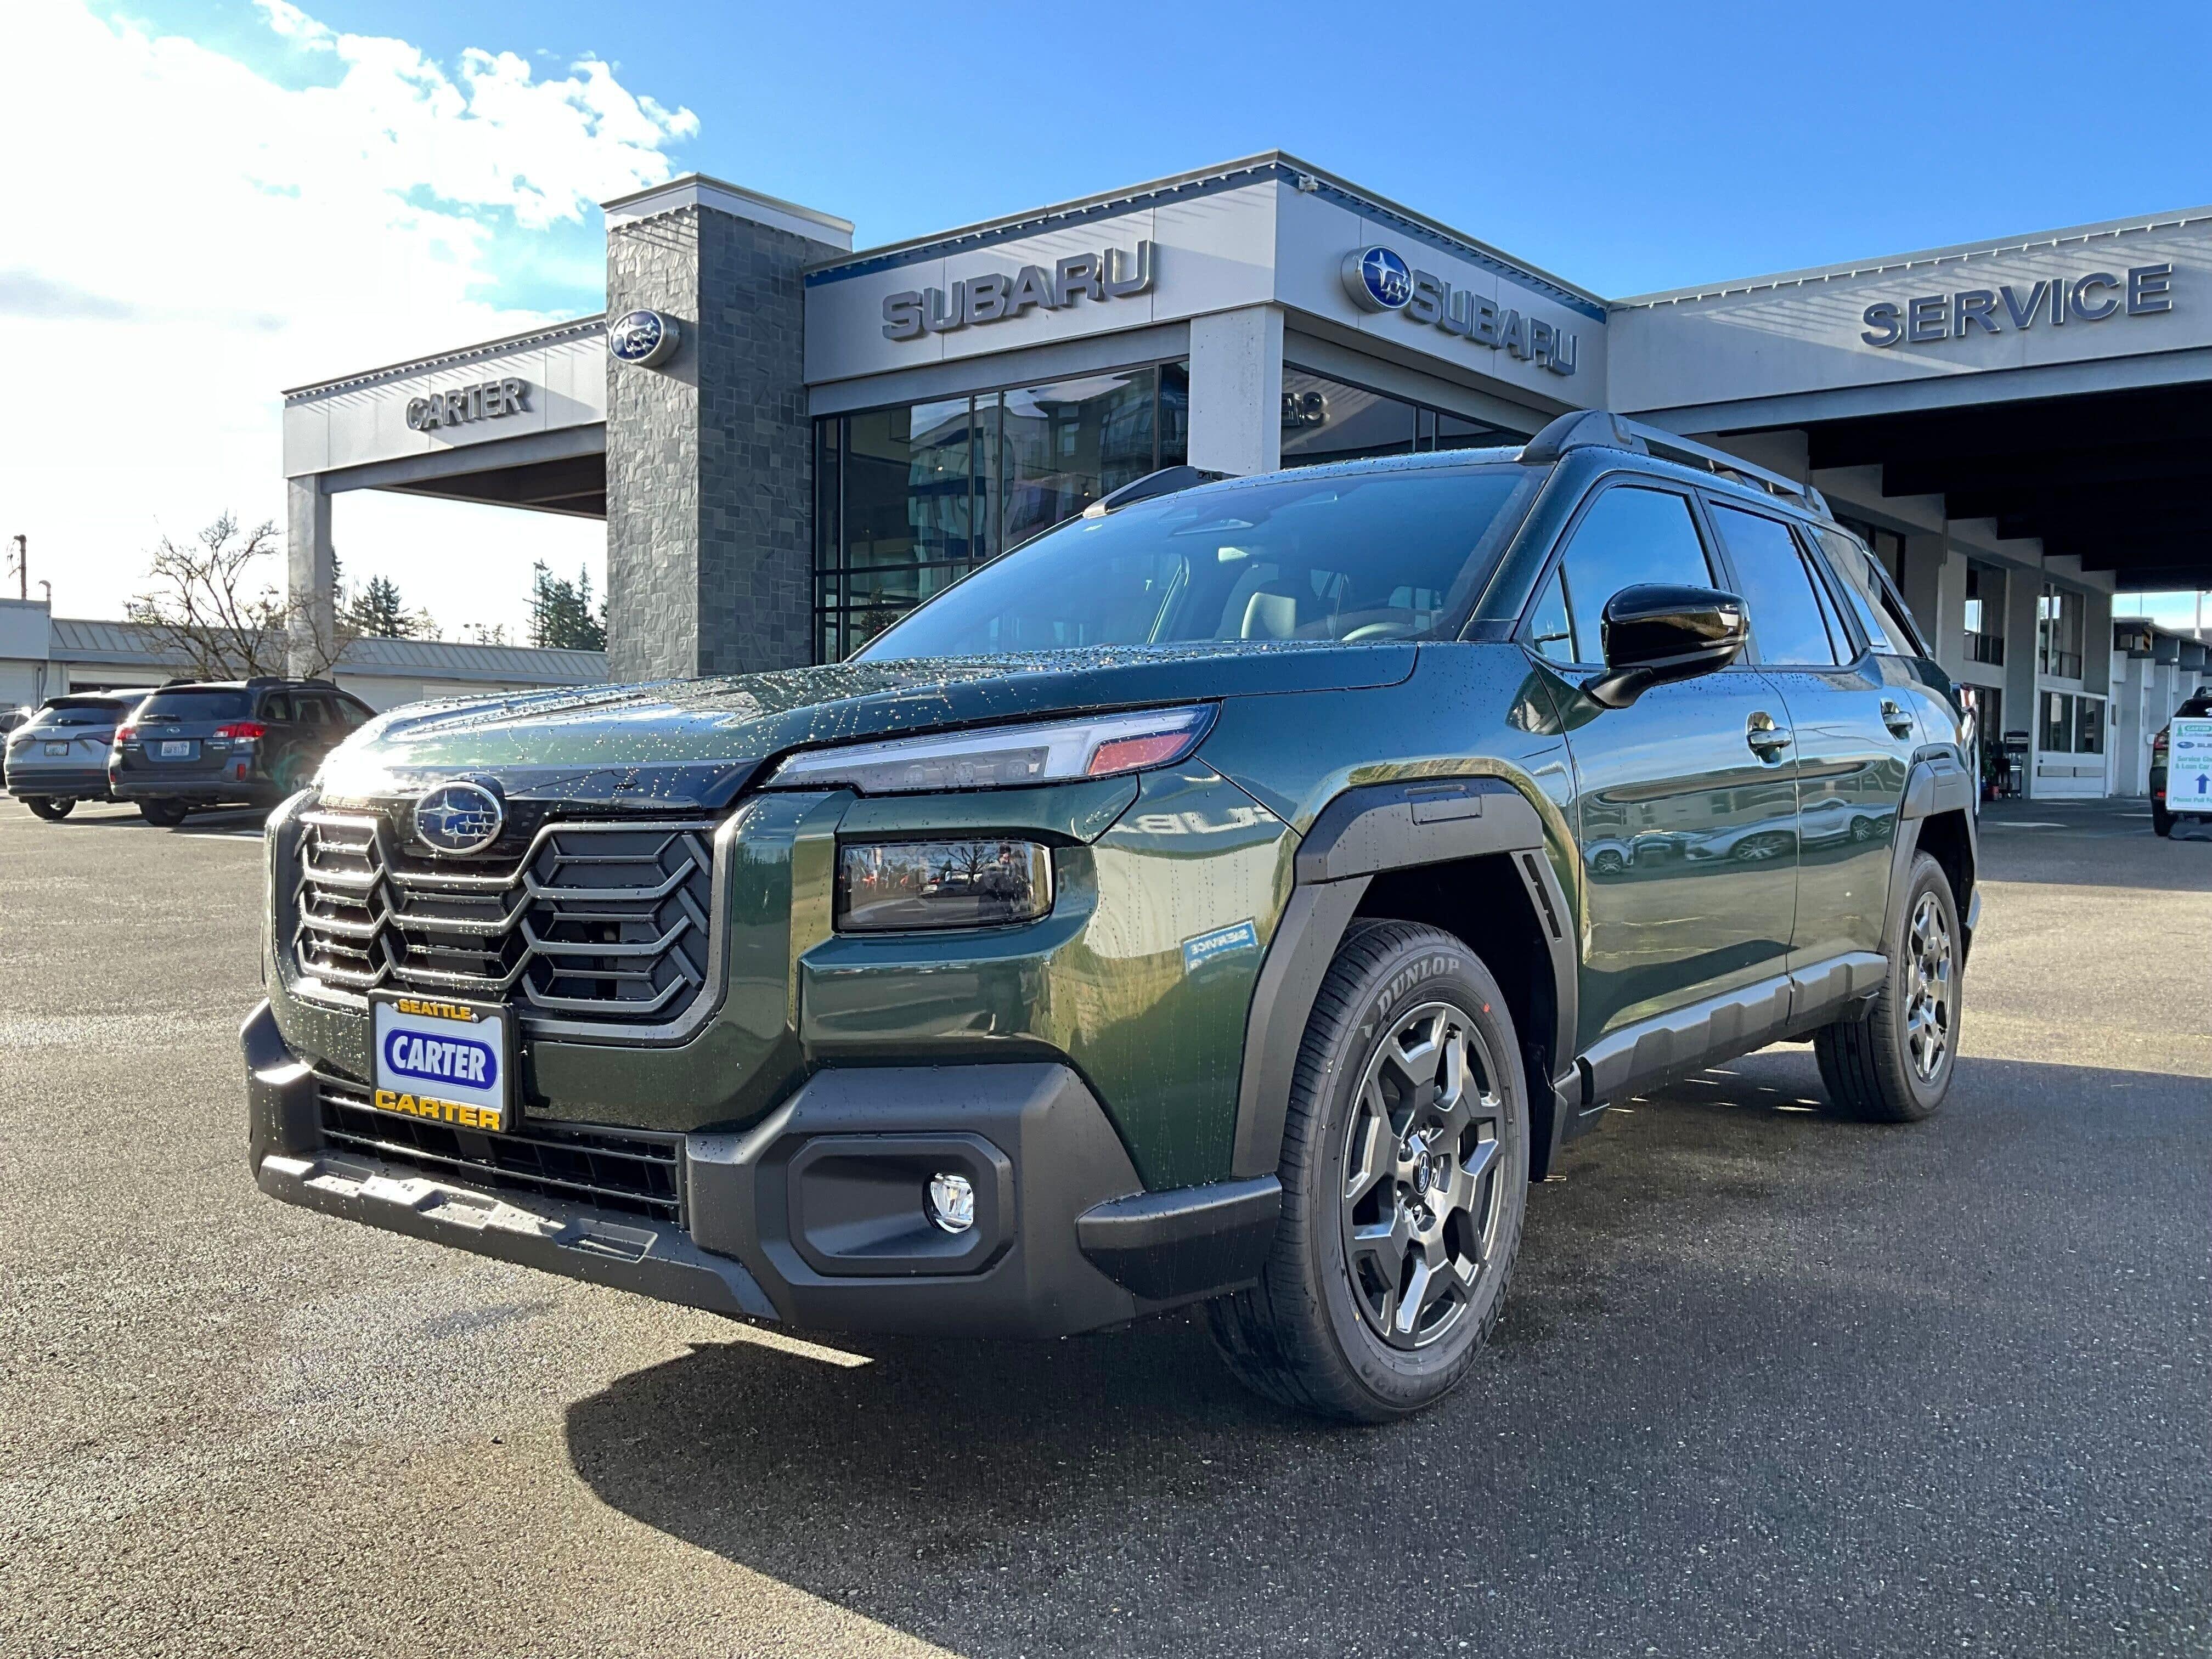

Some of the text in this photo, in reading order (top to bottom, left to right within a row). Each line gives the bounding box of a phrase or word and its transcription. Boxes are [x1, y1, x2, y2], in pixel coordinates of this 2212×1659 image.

[882, 239, 1152, 340] SUBARU
[1861, 263, 2172, 347] SERVICE
[1406, 269, 1578, 375] SUBARU
[407, 377, 522, 430] CARTER
[399, 998, 472, 1022] SEATTLE
[1376, 956, 1460, 1019] DUNLOP
[392, 1035, 486, 1082] CARTER
[375, 1089, 500, 1130] CARTER
